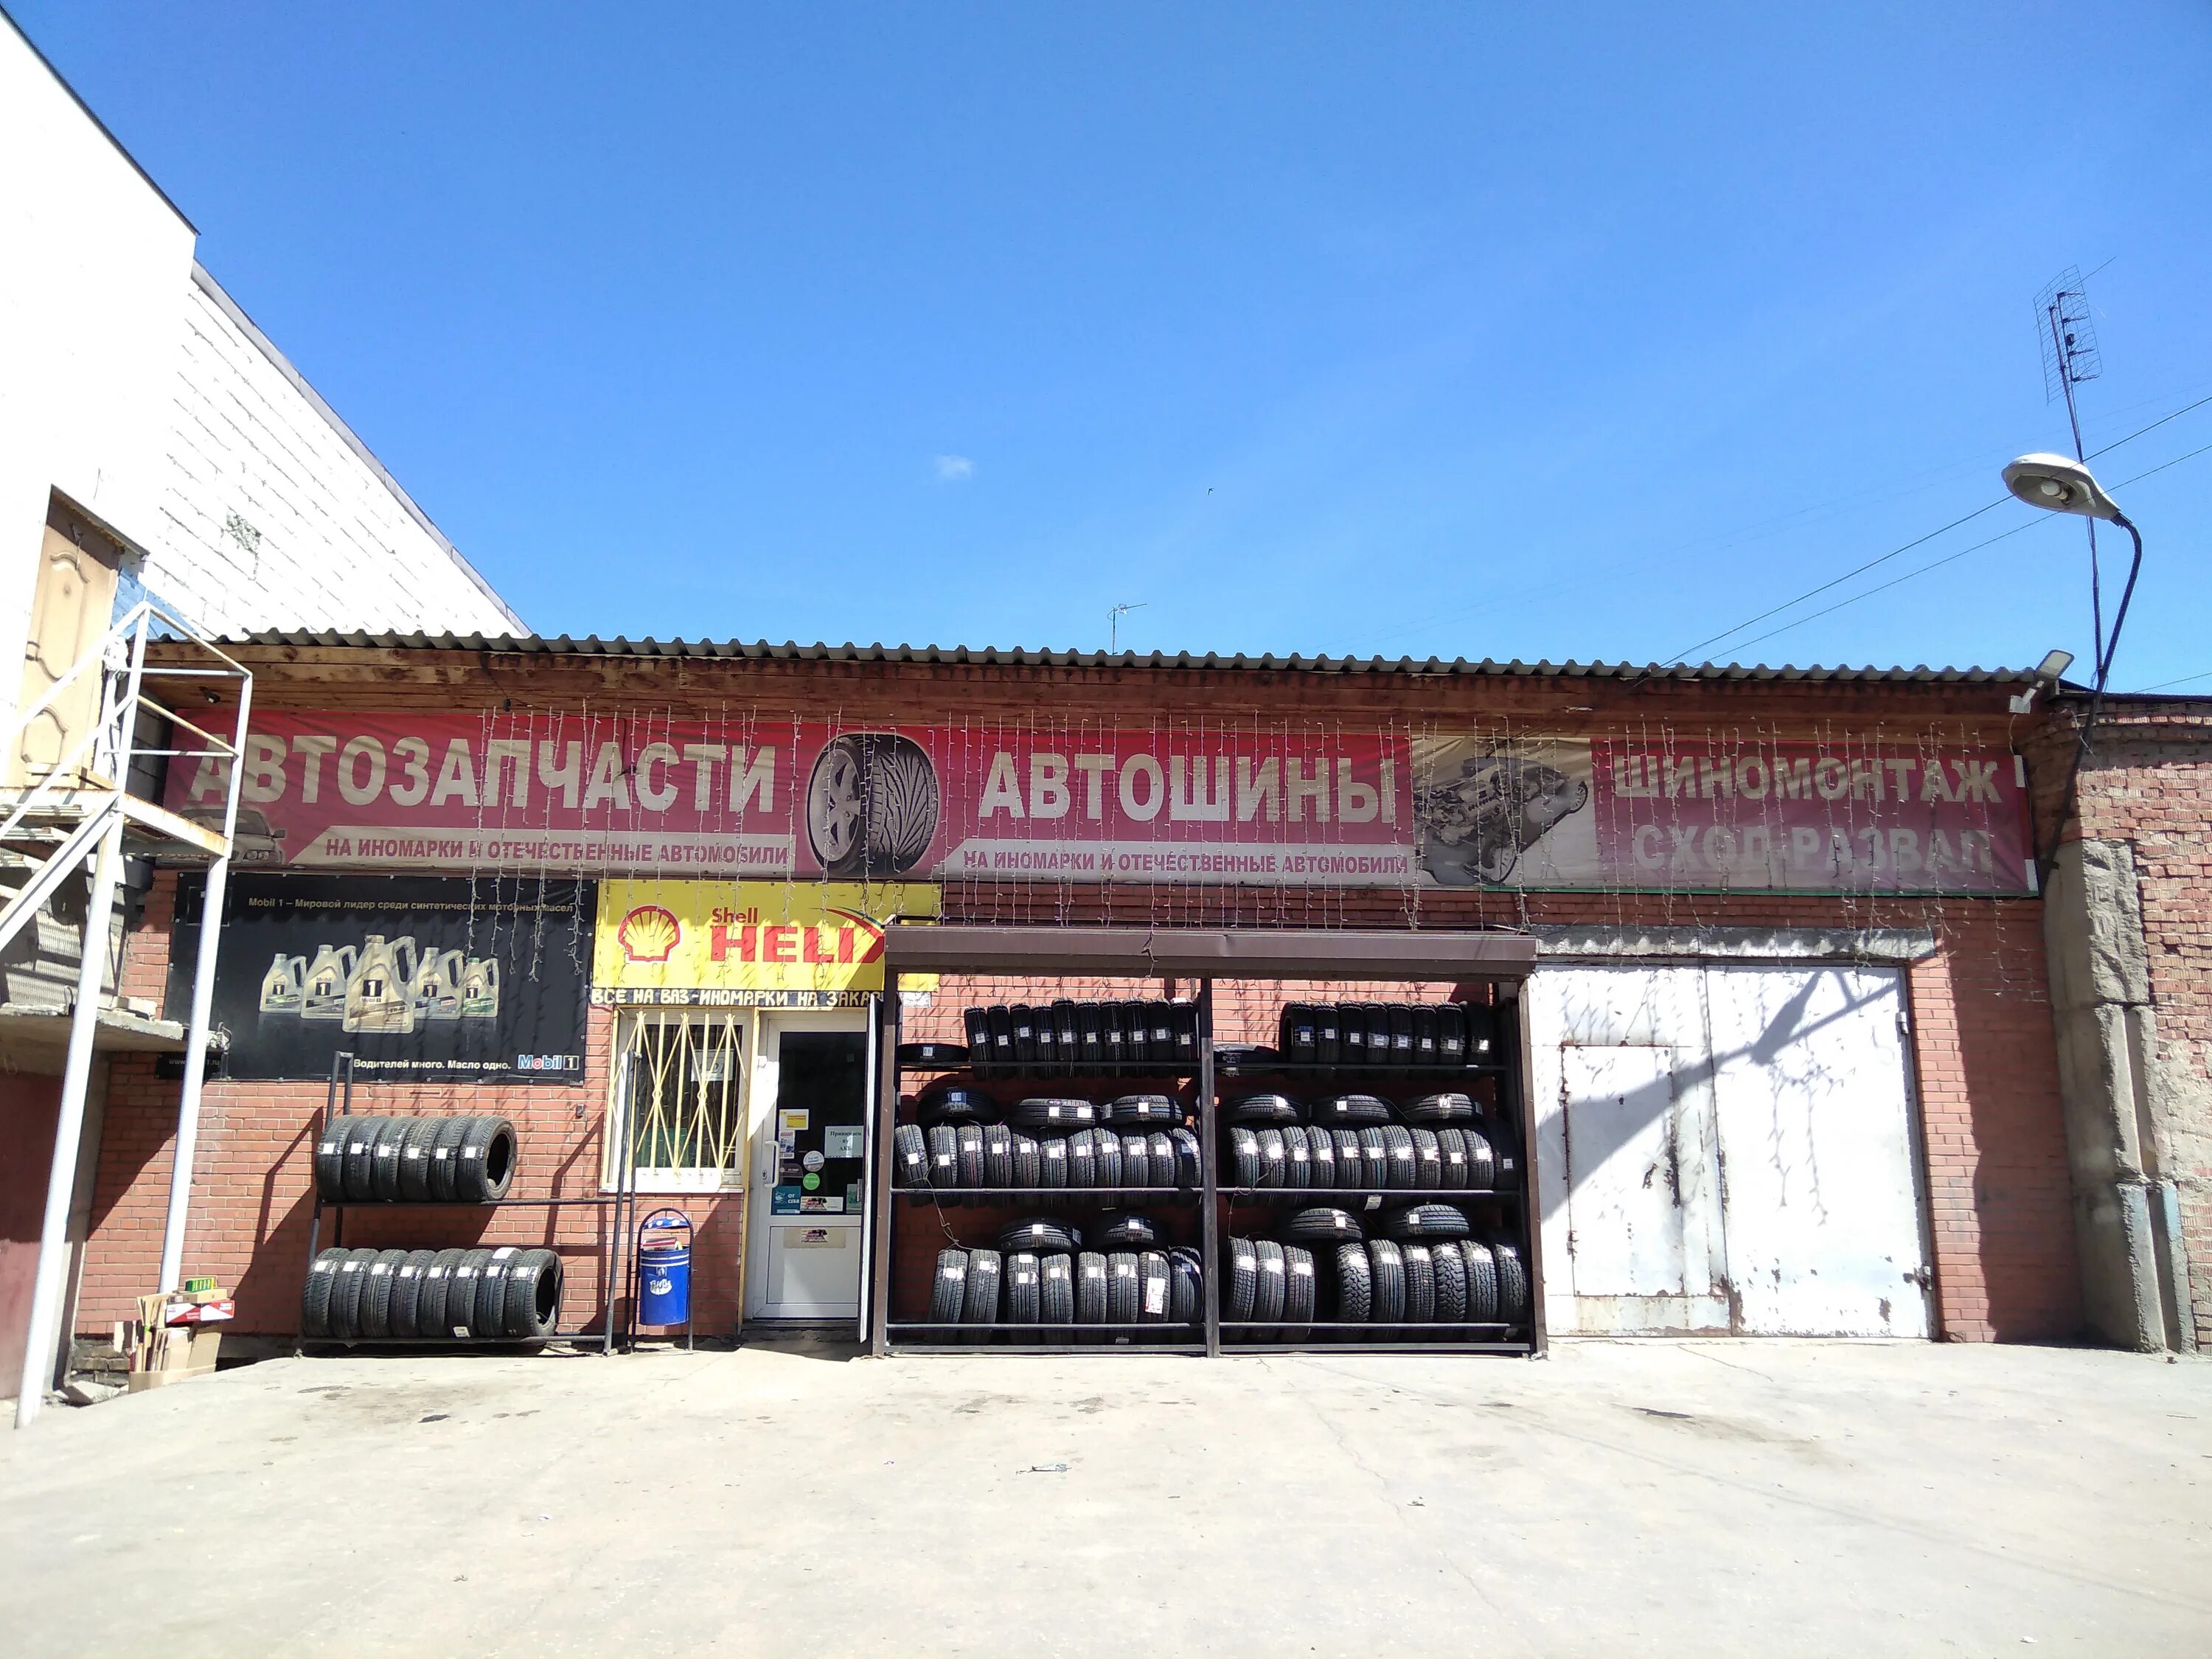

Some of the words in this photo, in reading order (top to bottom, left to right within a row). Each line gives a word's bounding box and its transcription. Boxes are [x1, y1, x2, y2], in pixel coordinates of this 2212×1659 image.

[187, 734, 776, 813] АВТОЗАПЧАСТИ
[1614, 755, 2003, 804] ШИНОМОНТАЖ
[978, 751, 1395, 824] АВТОШИНЫ
[325, 838, 352, 858] НА
[358, 838, 463, 860] ИНОМАРКИ
[468, 841, 481, 859] И
[487, 841, 653, 862] ОТЕЧЕСТВЕННЫЕ
[659, 844, 788, 864] АВТОМОБИЛИ
[963, 850, 989, 869] НА
[993, 852, 1095, 871] ИНОМАРКИ
[1101, 854, 1113, 871] И
[1121, 853, 1276, 872] ОТЕЧЕСТВЕННЫЕ
[1284, 855, 1408, 874] АВТОМОБИЛИ
[248, 897, 275, 907] Mobil
[278, 898, 283, 907] 1
[295, 898, 341, 910] Мировой
[343, 900, 375, 911] лидер
[378, 901, 408, 911] среди
[411, 901, 486, 911] синтетических
[488, 902, 539, 914] моторных
[542, 903, 573, 913] масел
[712, 906, 758, 924] Shell
[591, 989, 627, 1004] ВСЕ
[633, 990, 654, 1004] НА
[797, 990, 818, 1006] НА
[353, 1058, 409, 1069] Водителей
[411, 1060, 445, 1069] много.
[447, 1060, 480, 1069] Масло
[482, 1061, 511, 1071] одно.
[518, 1054, 563, 1070] Mobil
